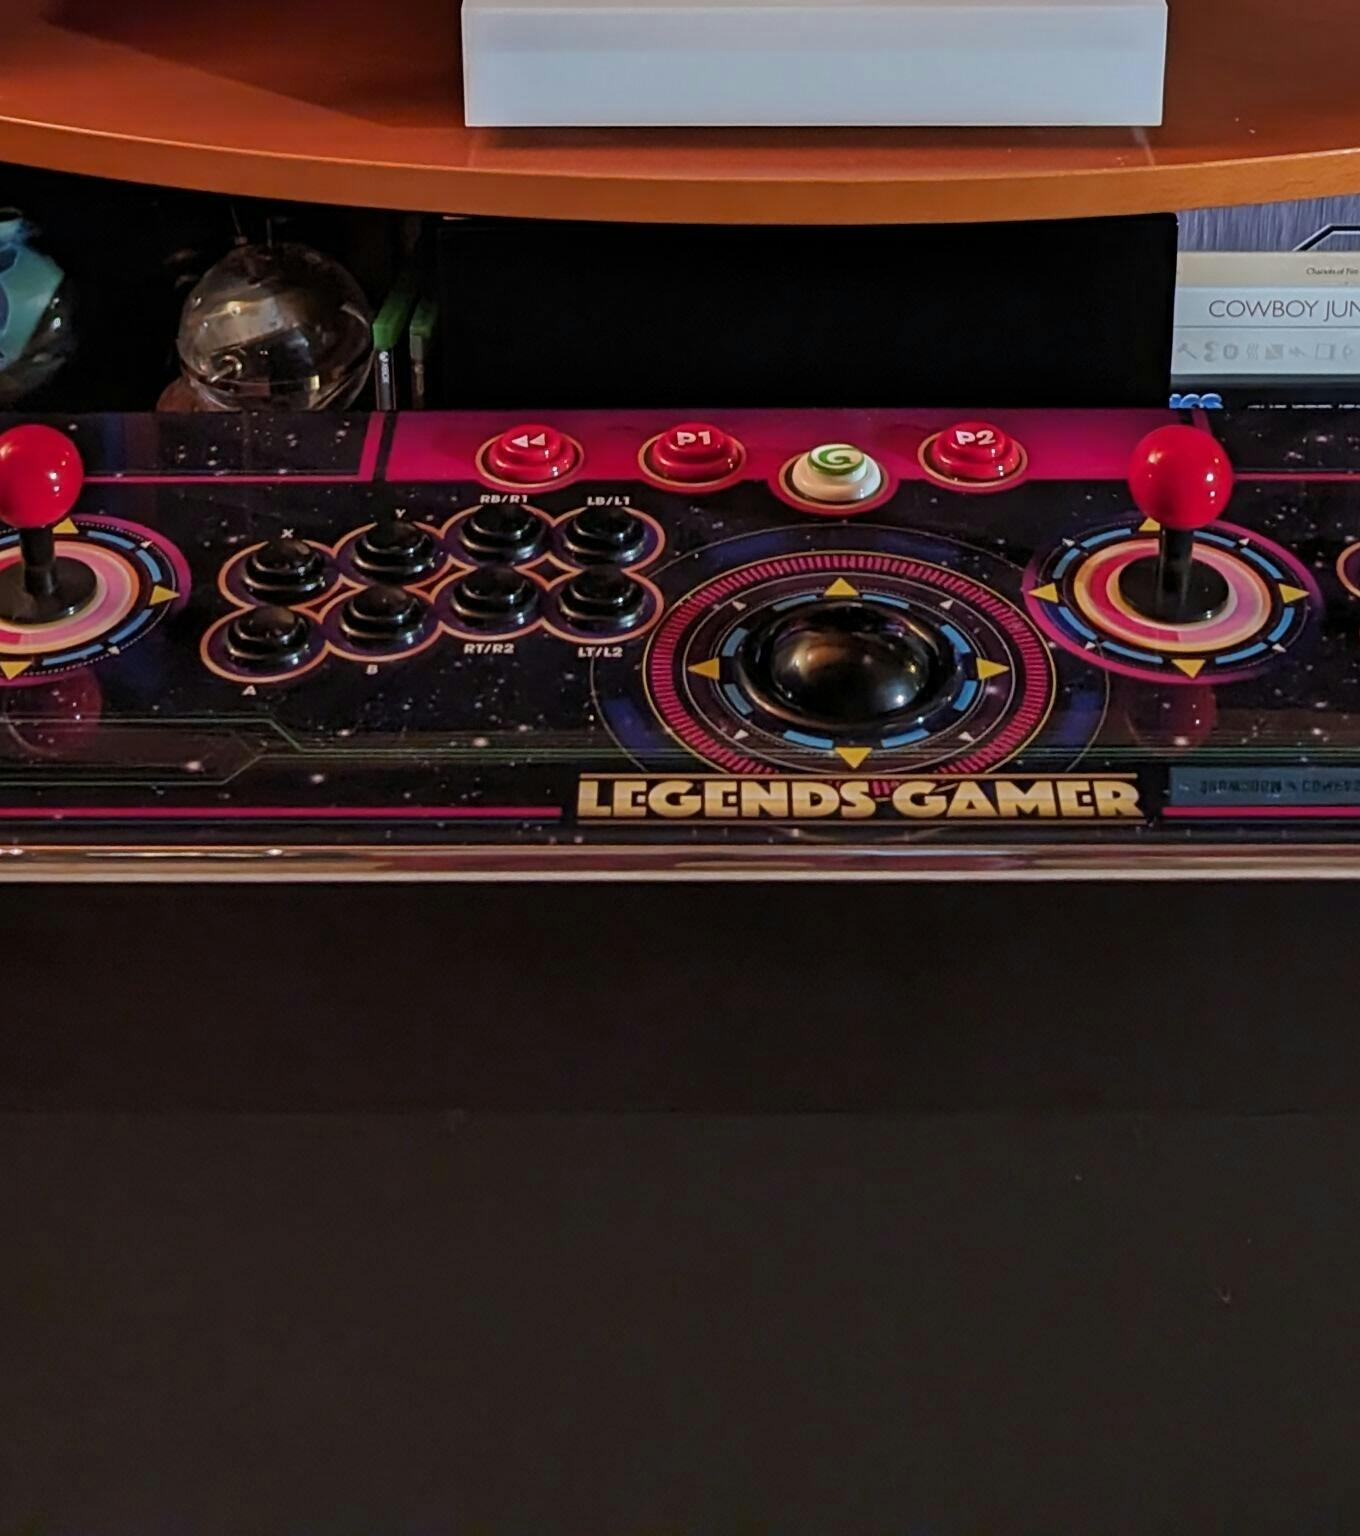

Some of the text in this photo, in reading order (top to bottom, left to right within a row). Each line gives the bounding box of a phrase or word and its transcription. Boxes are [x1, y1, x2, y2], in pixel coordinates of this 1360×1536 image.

[1209, 300, 1319, 318] COWBOY
[676, 429, 712, 446] P1
[955, 429, 997, 445] P2
[480, 494, 528, 504] RB/R1
[587, 496, 630, 506] LB/L1
[395, 509, 406, 518] Y
[281, 529, 294, 538] X
[463, 643, 515, 655] RT/R2
[578, 647, 623, 658] LT/L2
[366, 665, 379, 675] B
[242, 685, 257, 696] A
[577, 780, 1144, 818] LEGENDS GAMER
